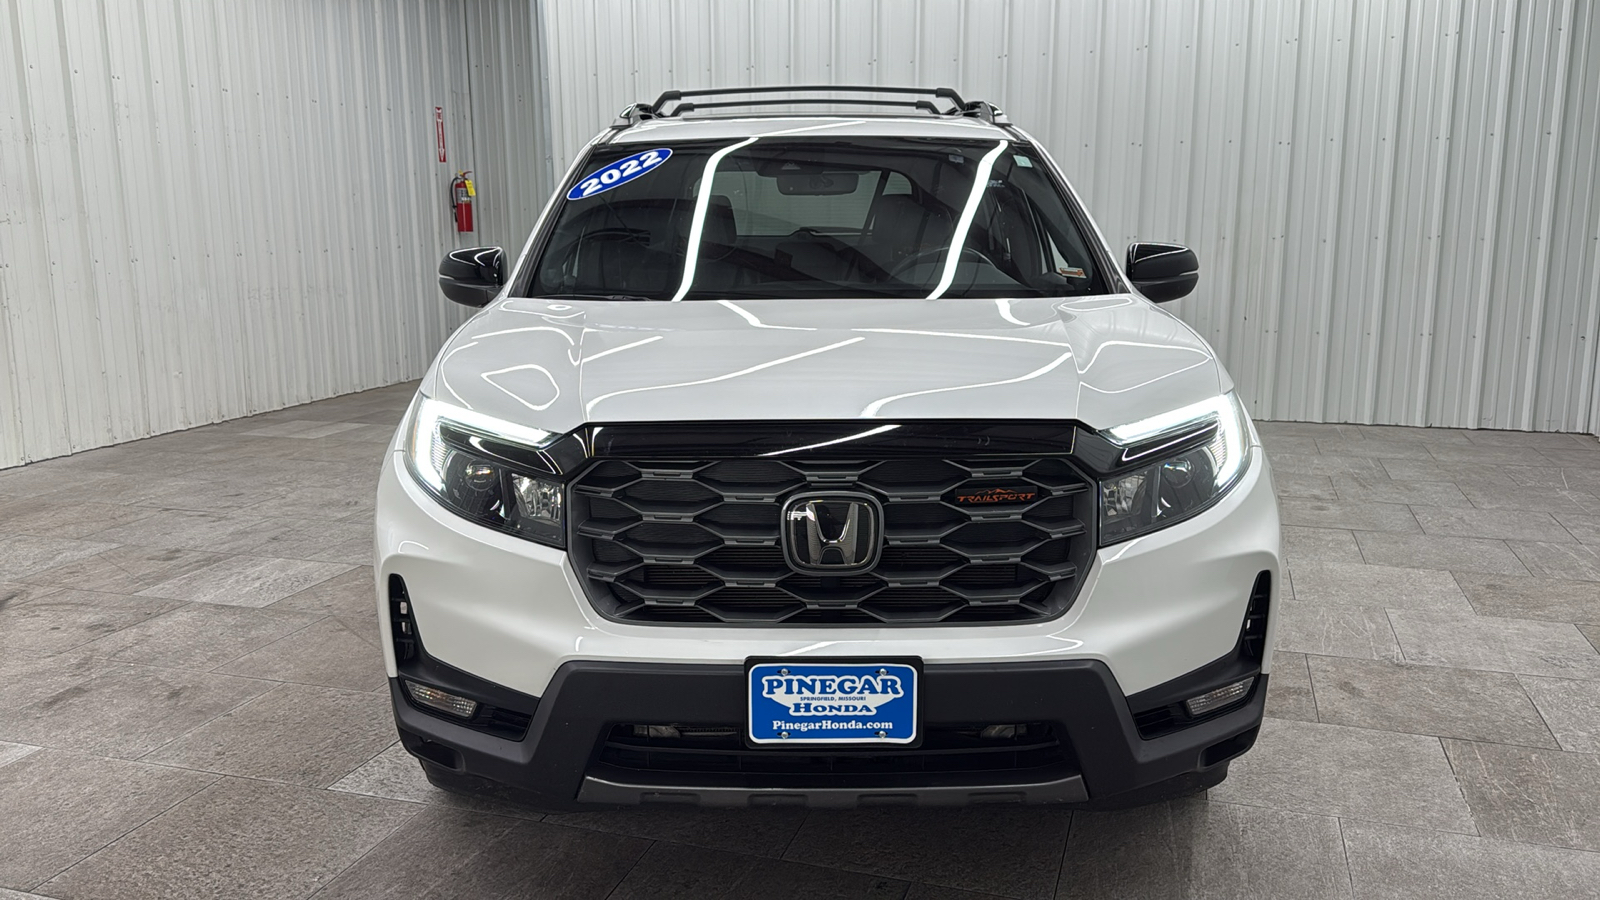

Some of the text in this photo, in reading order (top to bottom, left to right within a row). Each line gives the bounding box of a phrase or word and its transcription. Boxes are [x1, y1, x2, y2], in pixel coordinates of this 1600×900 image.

[580, 151, 662, 196] 2022
[957, 493, 1035, 503] TRAILSPORT
[764, 677, 902, 696] PINEGAR
[772, 719, 893, 731] PinegarHonda.com
